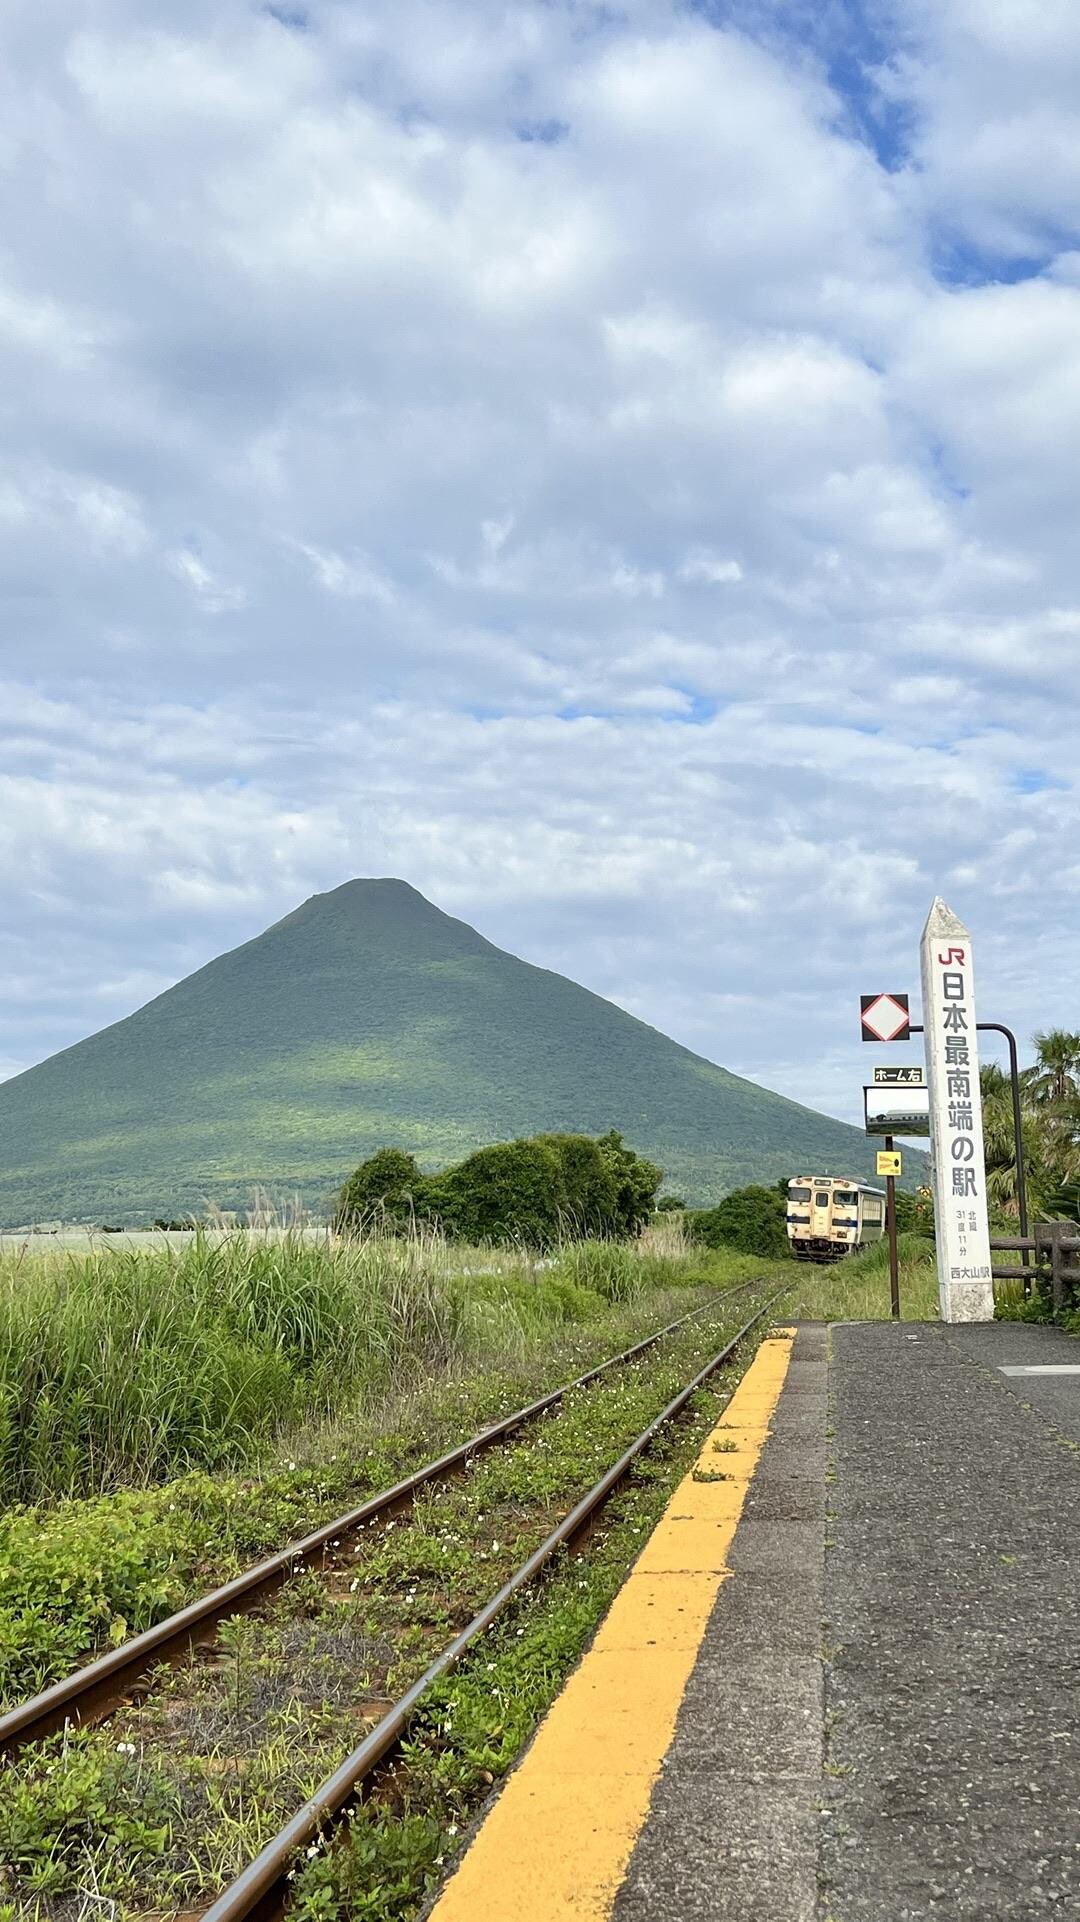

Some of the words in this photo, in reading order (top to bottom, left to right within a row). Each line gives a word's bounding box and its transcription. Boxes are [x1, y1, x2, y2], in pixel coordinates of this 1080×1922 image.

[938, 948, 965, 966] JR
[875, 1069, 921, 1082] ホーム右
[942, 972, 976, 1197] 日本最南端の駅
[951, 1267, 990, 1279] 西大山駅
